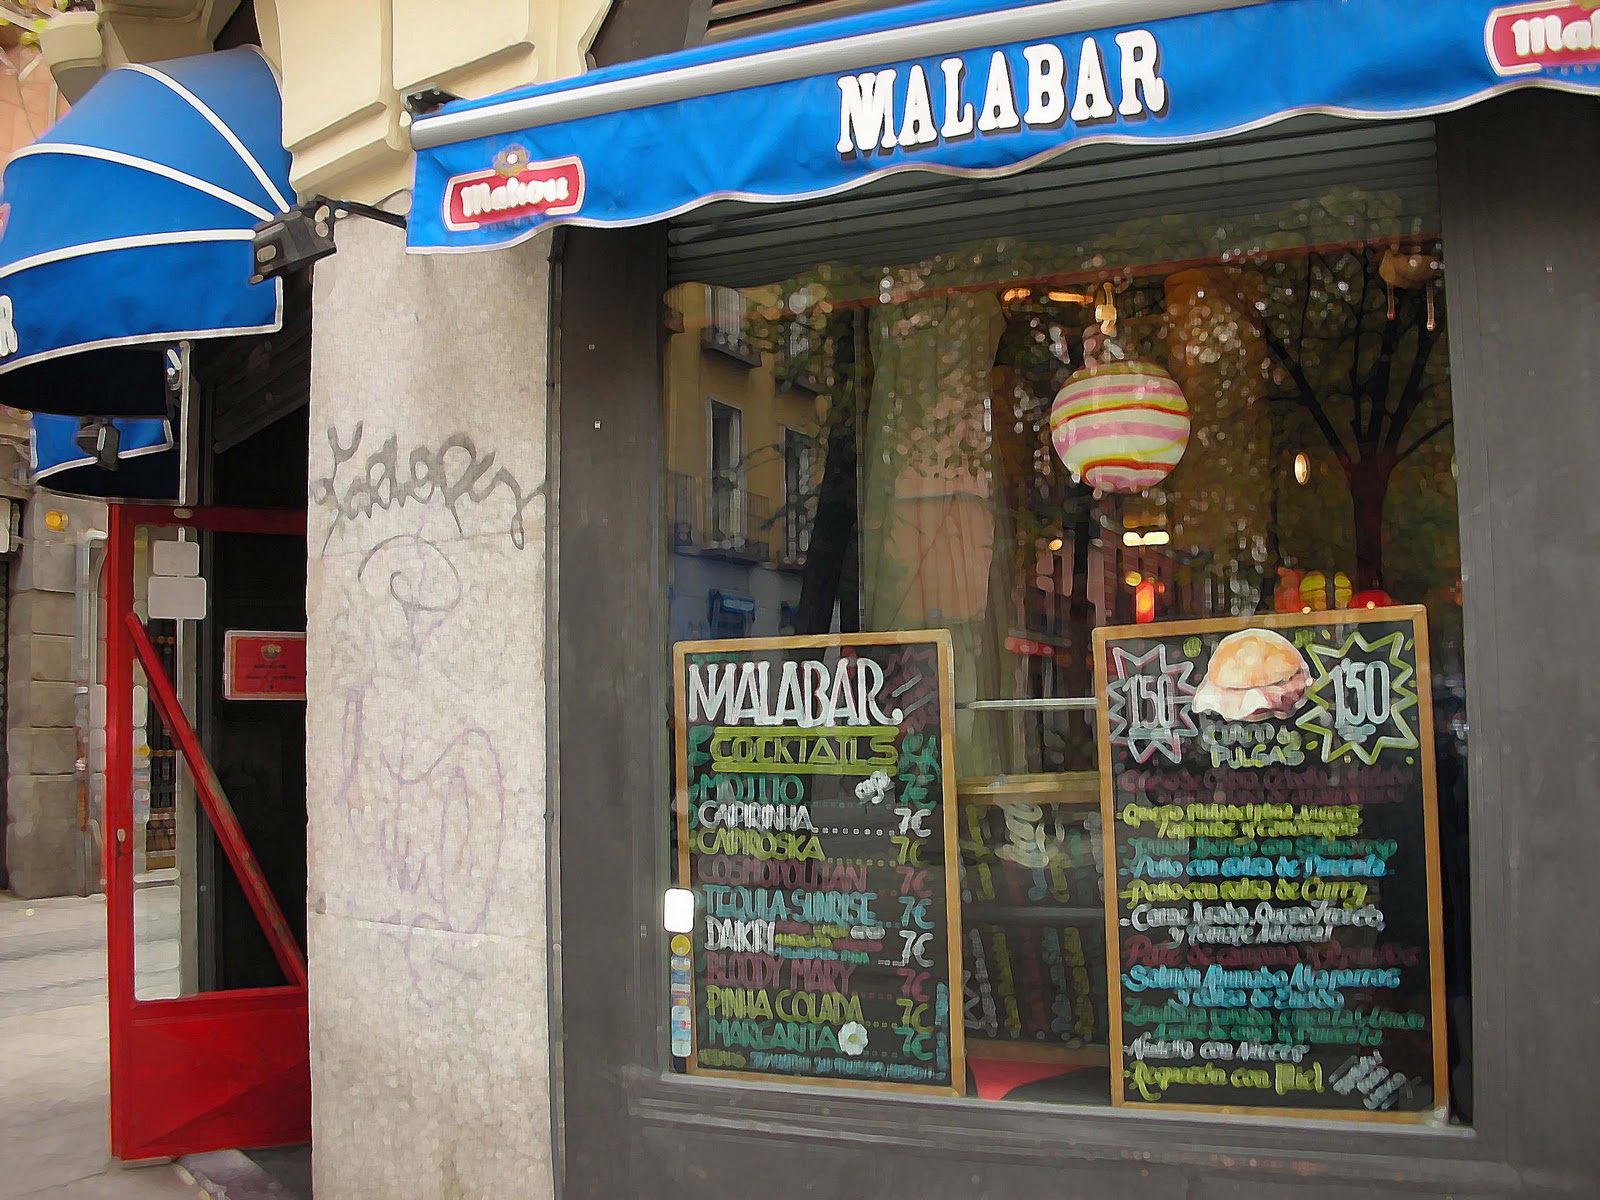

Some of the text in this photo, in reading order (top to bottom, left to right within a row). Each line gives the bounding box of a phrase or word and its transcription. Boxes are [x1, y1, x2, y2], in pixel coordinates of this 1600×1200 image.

[836, 29, 1168, 160] MALABAR
[689, 657, 904, 728] MALABAR
[710, 734, 899, 765] COCKTAILS
[789, 958, 858, 996] MARY
[774, 989, 865, 1026] COLADA
[1230, 1067, 1273, 1090] con
